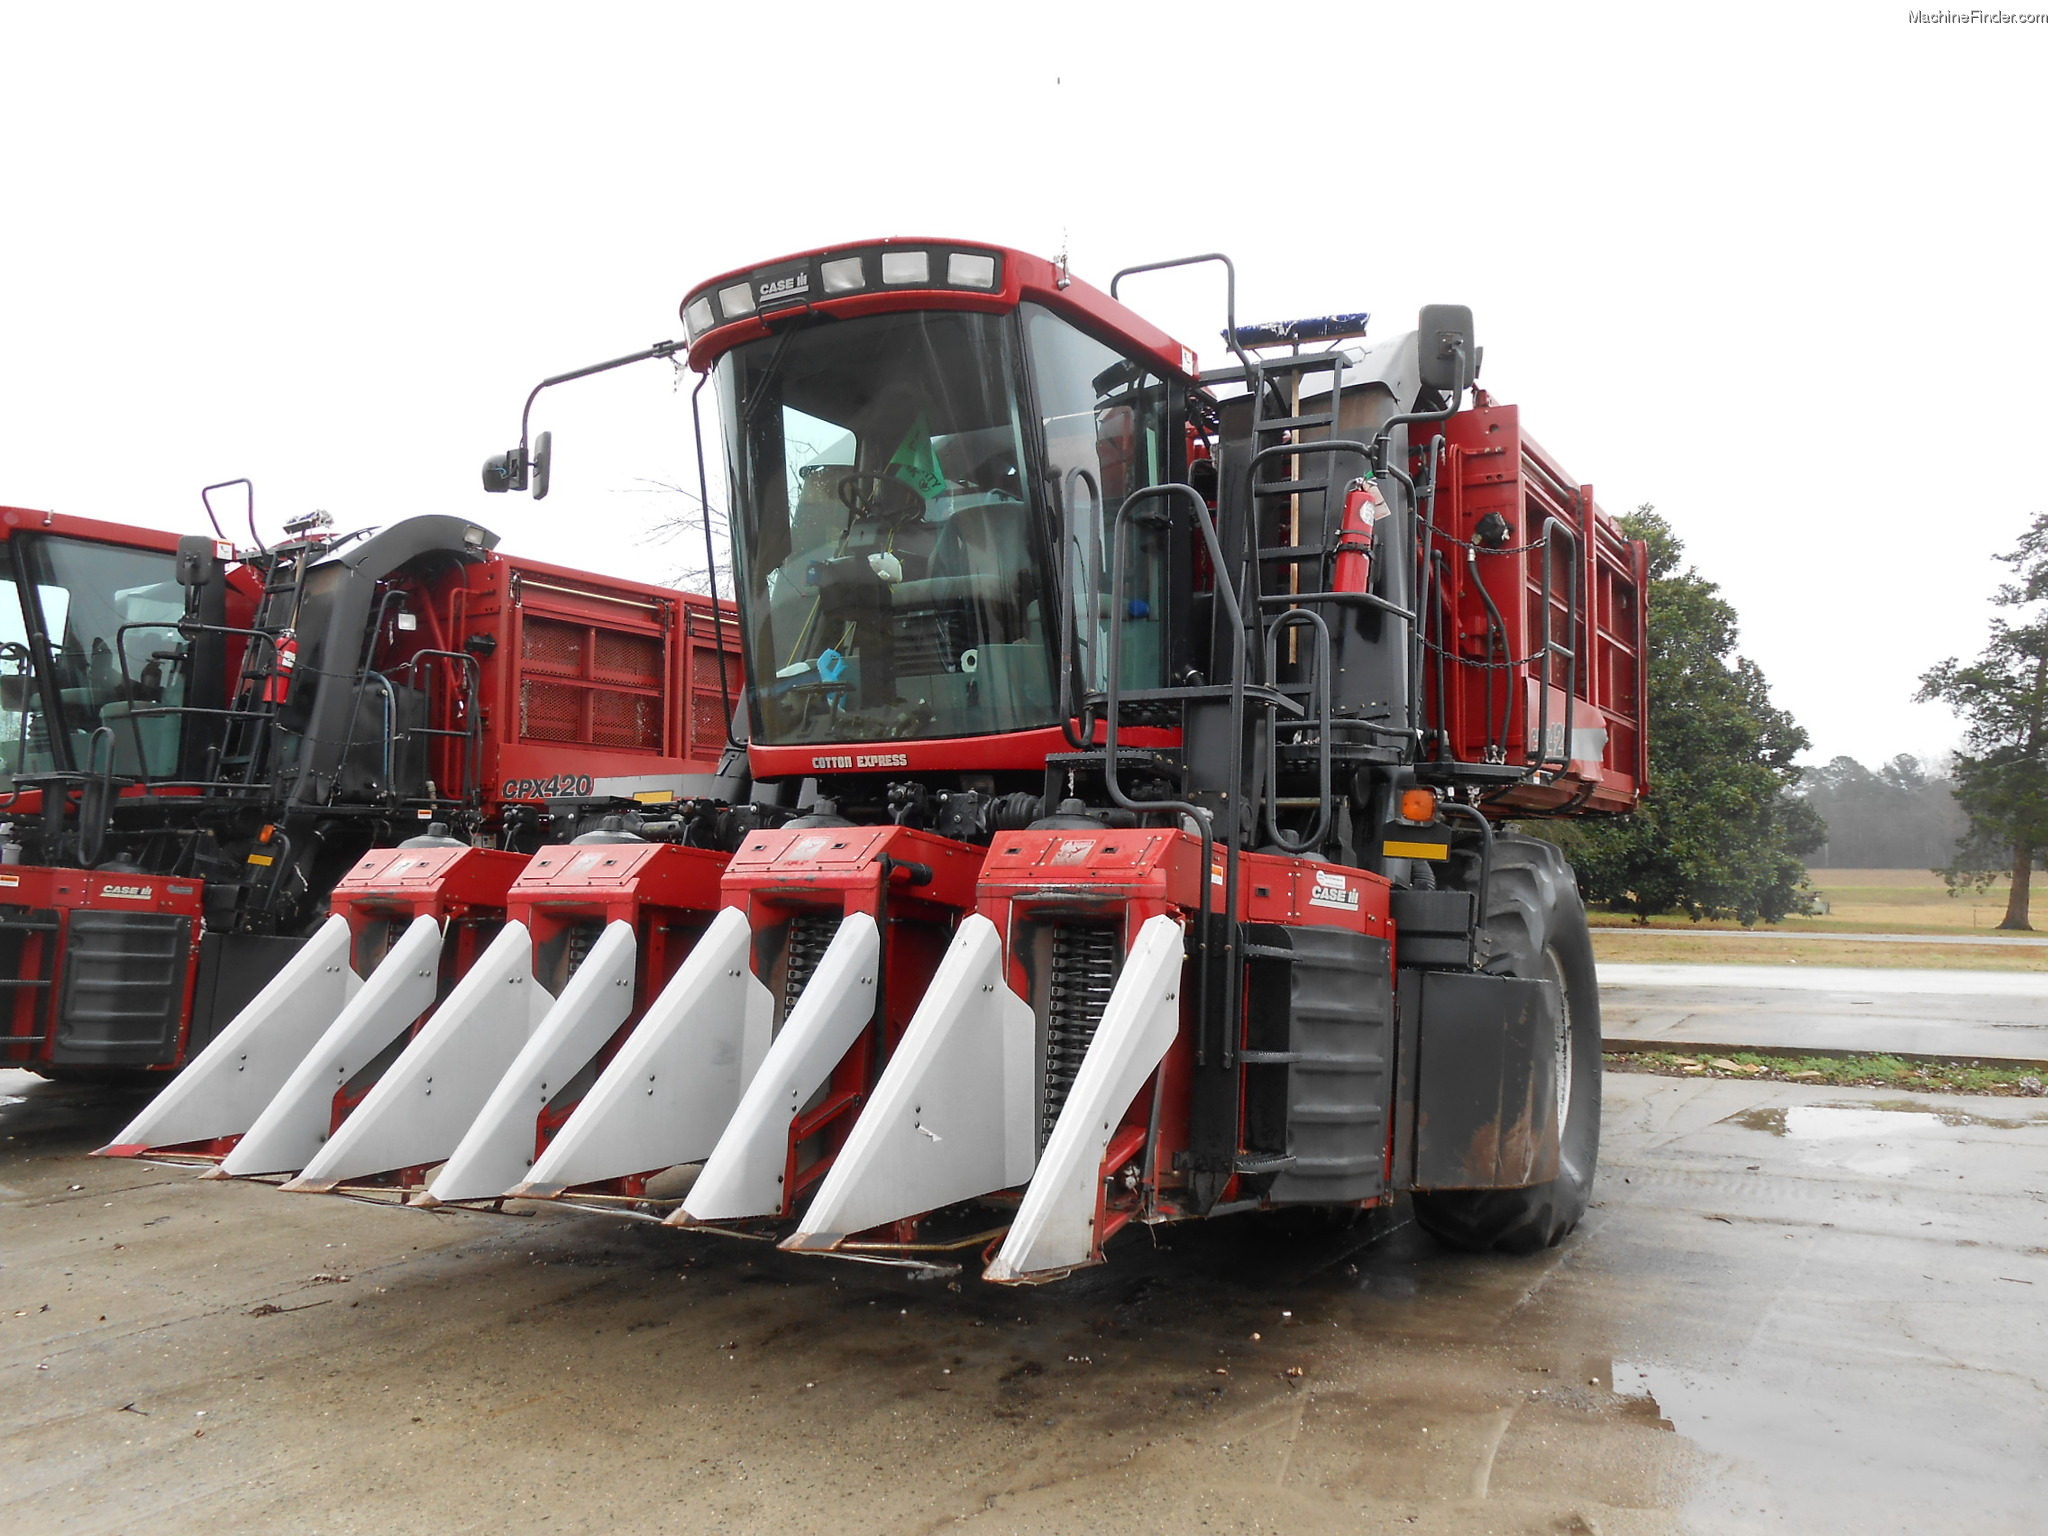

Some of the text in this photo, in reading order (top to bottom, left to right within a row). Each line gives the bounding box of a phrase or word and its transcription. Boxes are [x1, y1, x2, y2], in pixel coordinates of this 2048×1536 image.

[760, 278, 794, 295] CASE
[812, 754, 908, 769] COTTON EXPRESS
[502, 774, 594, 799] CPX420
[103, 885, 140, 895] CASE
[1311, 885, 1346, 902] CASE
